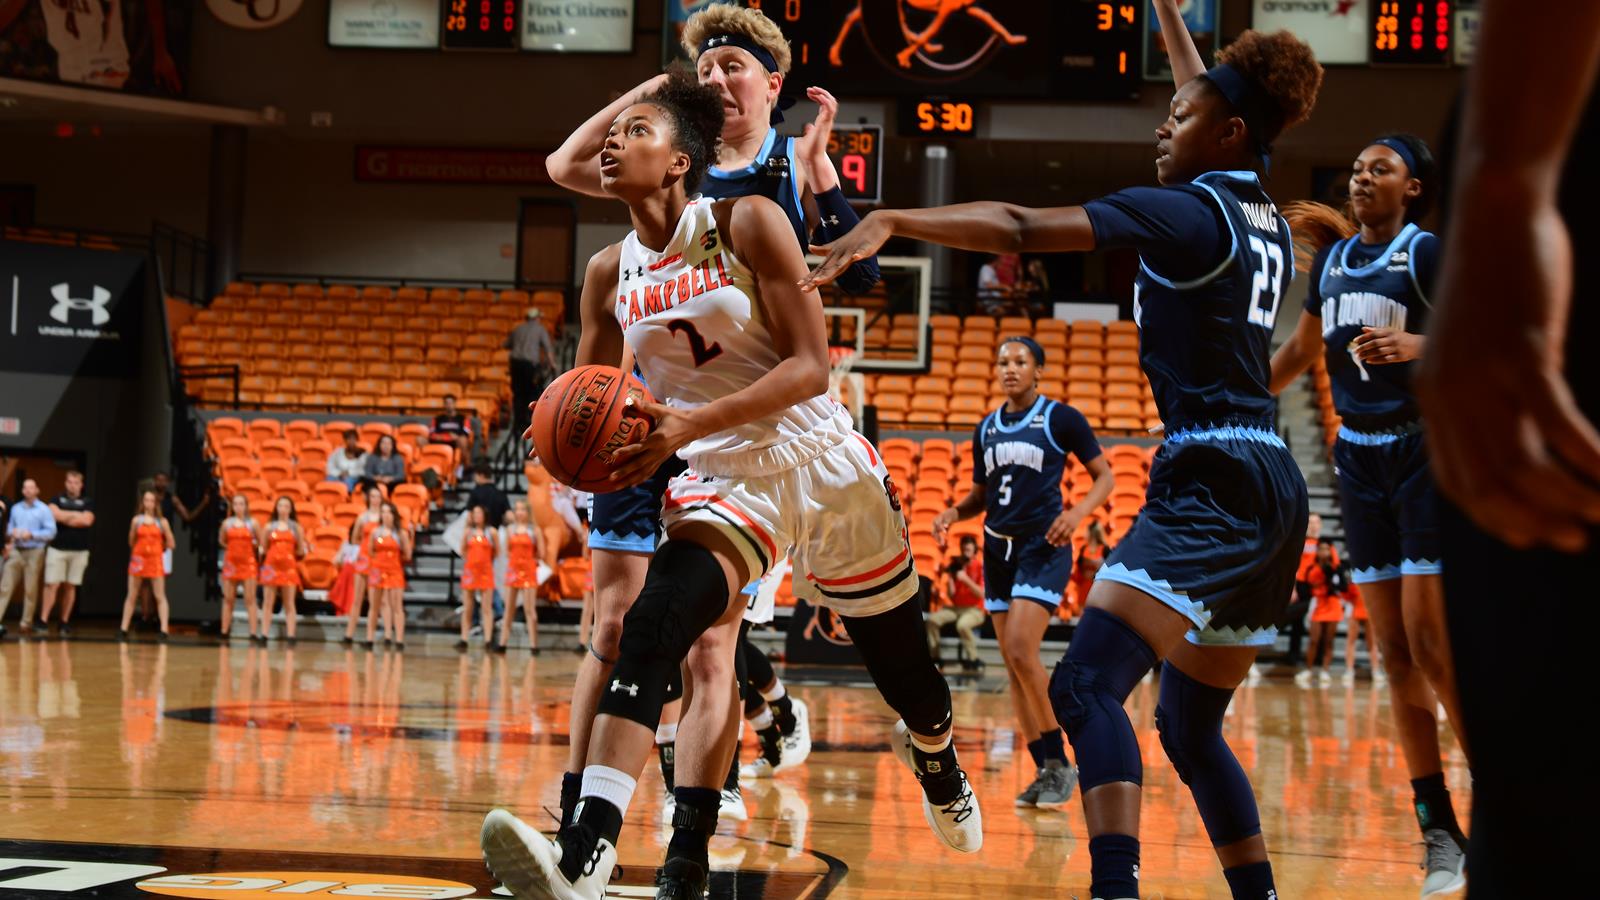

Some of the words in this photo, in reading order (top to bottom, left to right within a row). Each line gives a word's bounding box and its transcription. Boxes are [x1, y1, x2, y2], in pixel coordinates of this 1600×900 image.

[527, 1, 561, 17] First
[565, 1, 629, 17] Citizens
[527, 21, 566, 35] Bank
[917, 102, 973, 131] 5:30
[827, 132, 873, 154] 5:30
[485, 163, 549, 180] CAMEL
[842, 155, 866, 192] 9
[618, 253, 735, 331] CAMPBELL
[1247, 234, 1284, 329] 23
[667, 318, 724, 369] 2
[998, 475, 1013, 506] 5
